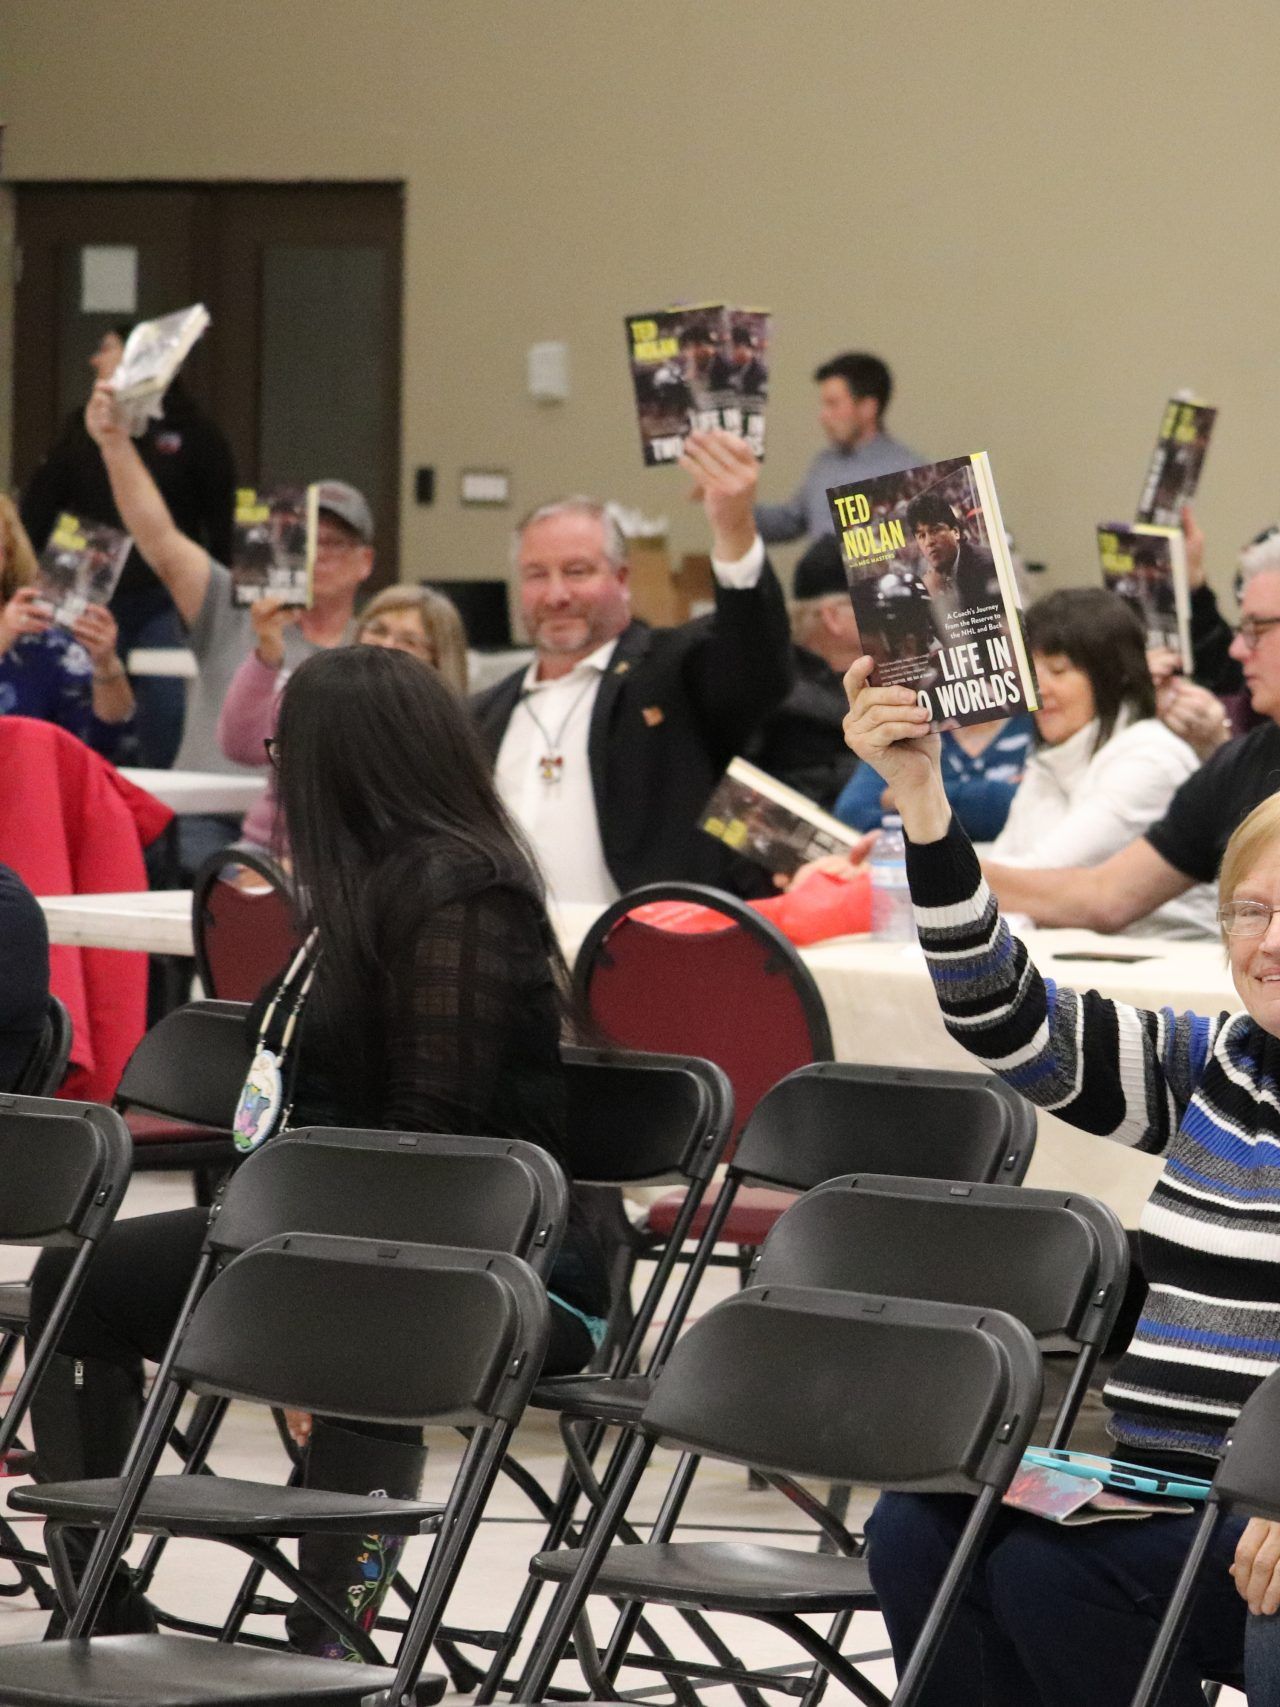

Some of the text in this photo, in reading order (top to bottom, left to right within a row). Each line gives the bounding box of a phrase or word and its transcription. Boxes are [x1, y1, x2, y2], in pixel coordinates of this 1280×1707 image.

[834, 493, 871, 527] TED
[842, 519, 906, 559] NOLAN
[952, 607, 975, 619] Coach's
[976, 604, 999, 614] Journey
[970, 615, 994, 625] Reserve
[950, 621, 1003, 639] the NHL and Back
[938, 642, 985, 682] LIFE
[985, 635, 1013, 671] IN
[935, 671, 1021, 718] WORLDS
